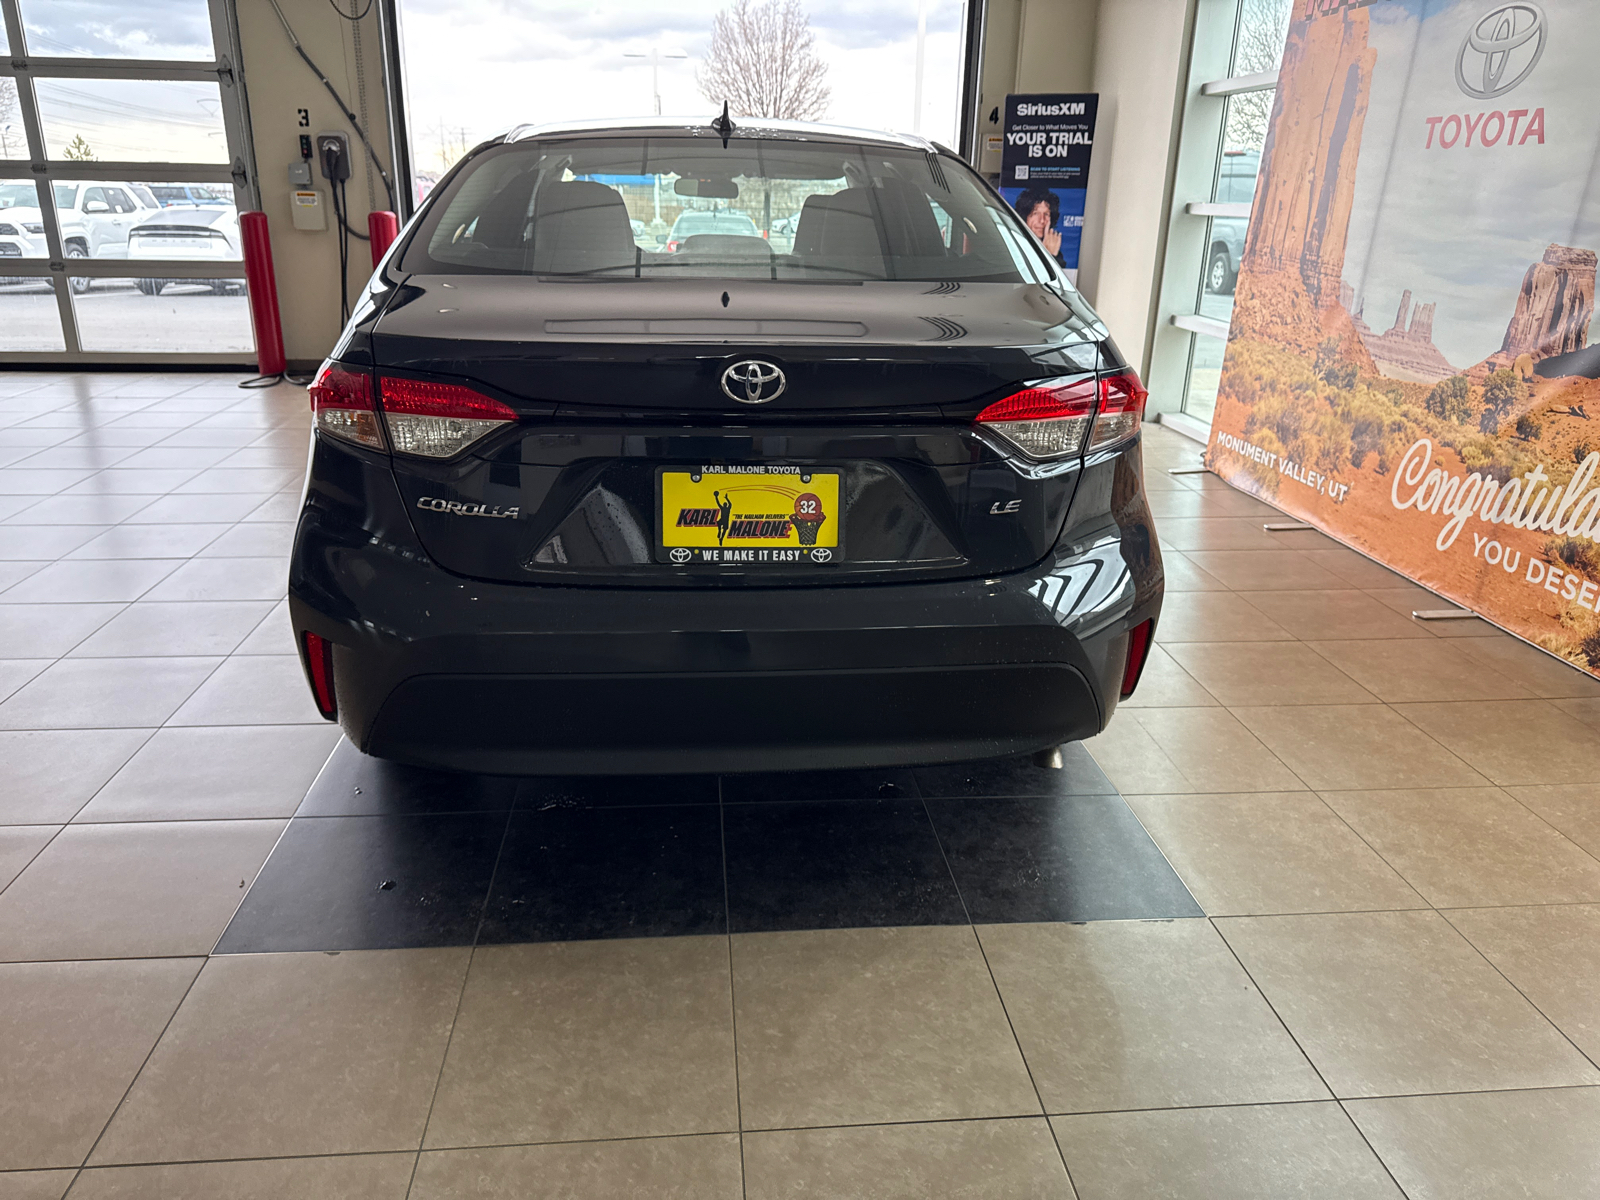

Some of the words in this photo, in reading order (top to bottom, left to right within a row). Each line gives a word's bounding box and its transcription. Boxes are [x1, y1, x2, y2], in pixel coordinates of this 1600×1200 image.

[298, 109, 309, 127] 3
[989, 106, 999, 125] 4
[1017, 102, 1085, 116] SiriusXM
[1425, 108, 1545, 150] TOYOTA
[1007, 132, 1047, 145] YOUR
[1050, 132, 1092, 145] TRIAL
[1028, 145, 1043, 157] IS
[1045, 145, 1068, 157] ON
[701, 465, 726, 474] KARL
[728, 465, 765, 474] MALONE
[767, 466, 801, 474] TOYOTA
[1217, 431, 1277, 468] MONUMENT
[1279, 458, 1325, 495] VALLEY,
[1328, 480, 1348, 501] UT
[417, 496, 520, 519] COROLLA
[800, 500, 816, 514] 32
[989, 499, 1022, 514] LE
[676, 508, 720, 527] KARL
[727, 519, 792, 538] MALONE
[702, 550, 719, 561] WE
[723, 550, 755, 561] MAKE
[758, 550, 769, 561] IT
[772, 550, 800, 561] EASY
[1473, 532, 1521, 573] YOU
